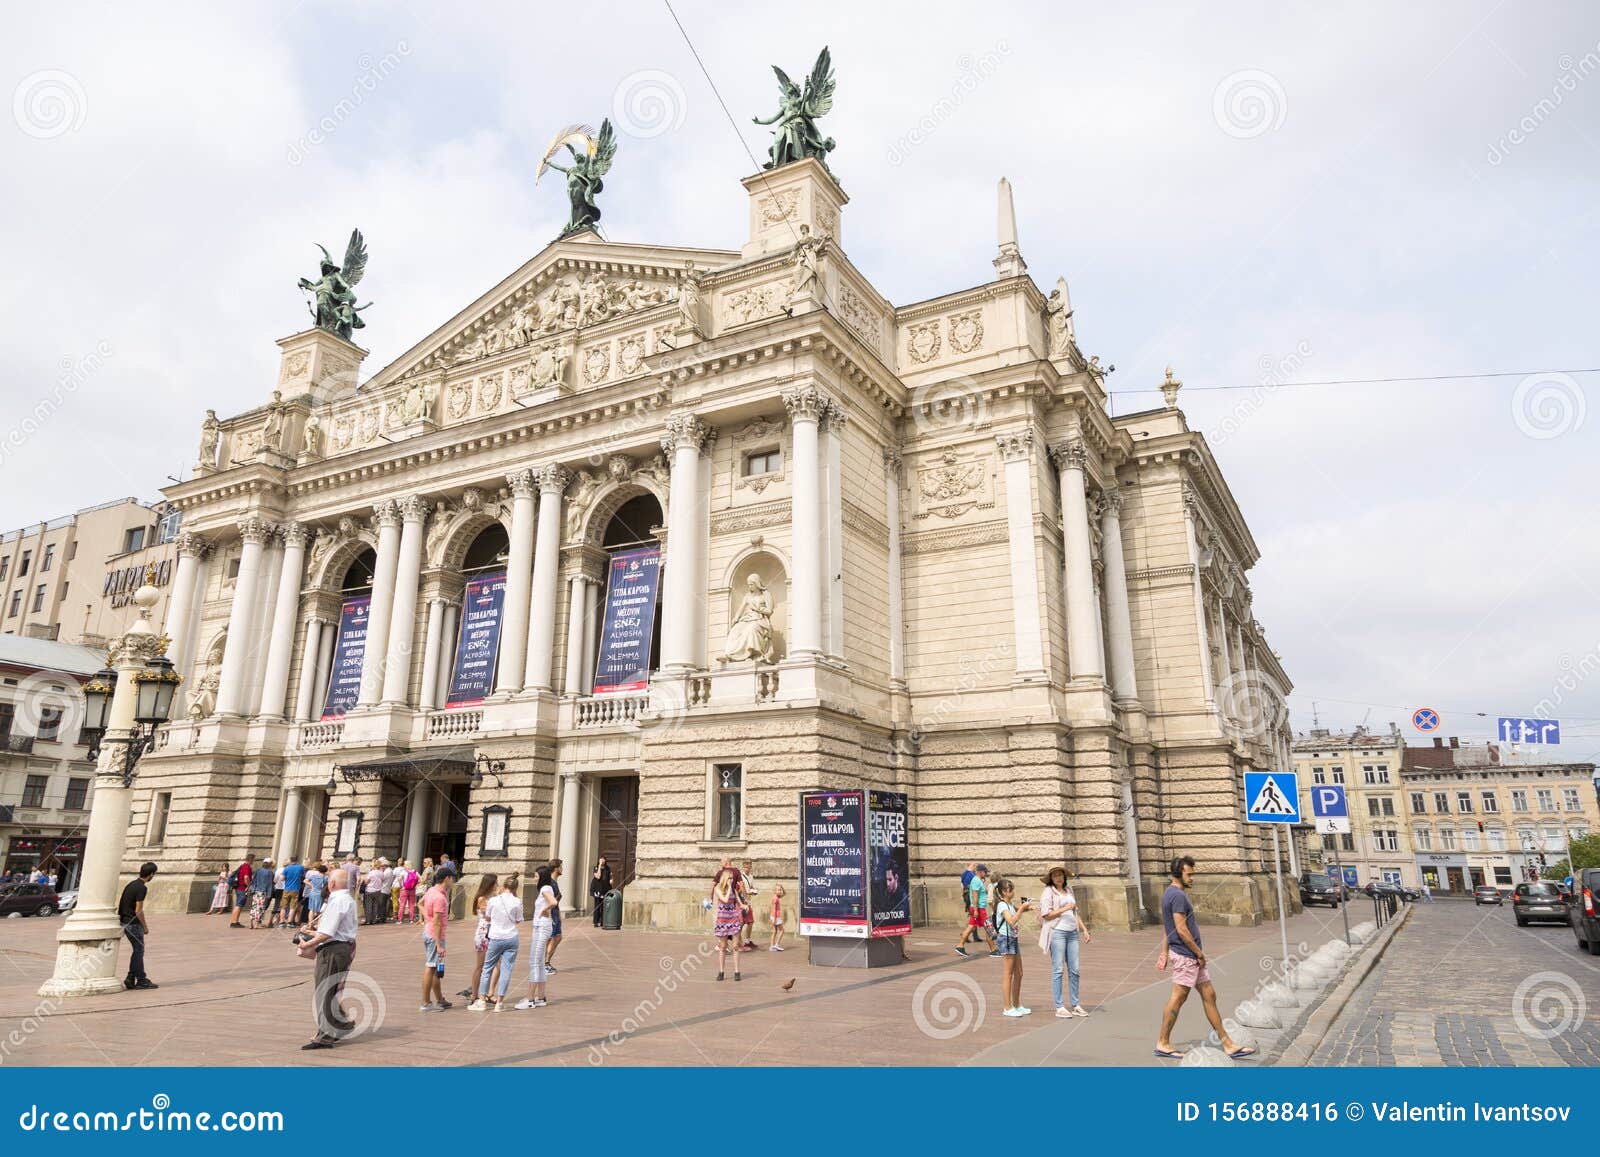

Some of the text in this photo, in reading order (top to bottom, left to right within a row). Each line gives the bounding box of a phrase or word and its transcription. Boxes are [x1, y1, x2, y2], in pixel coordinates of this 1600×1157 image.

[1320, 790, 1338, 814] P
[870, 810, 905, 830] PETER
[870, 829, 905, 848] BENCE
[822, 848, 861, 856] ALYOSHA
[806, 855, 833, 866] MÉLOVIN
[874, 910, 905, 920] WORLD TOUR
